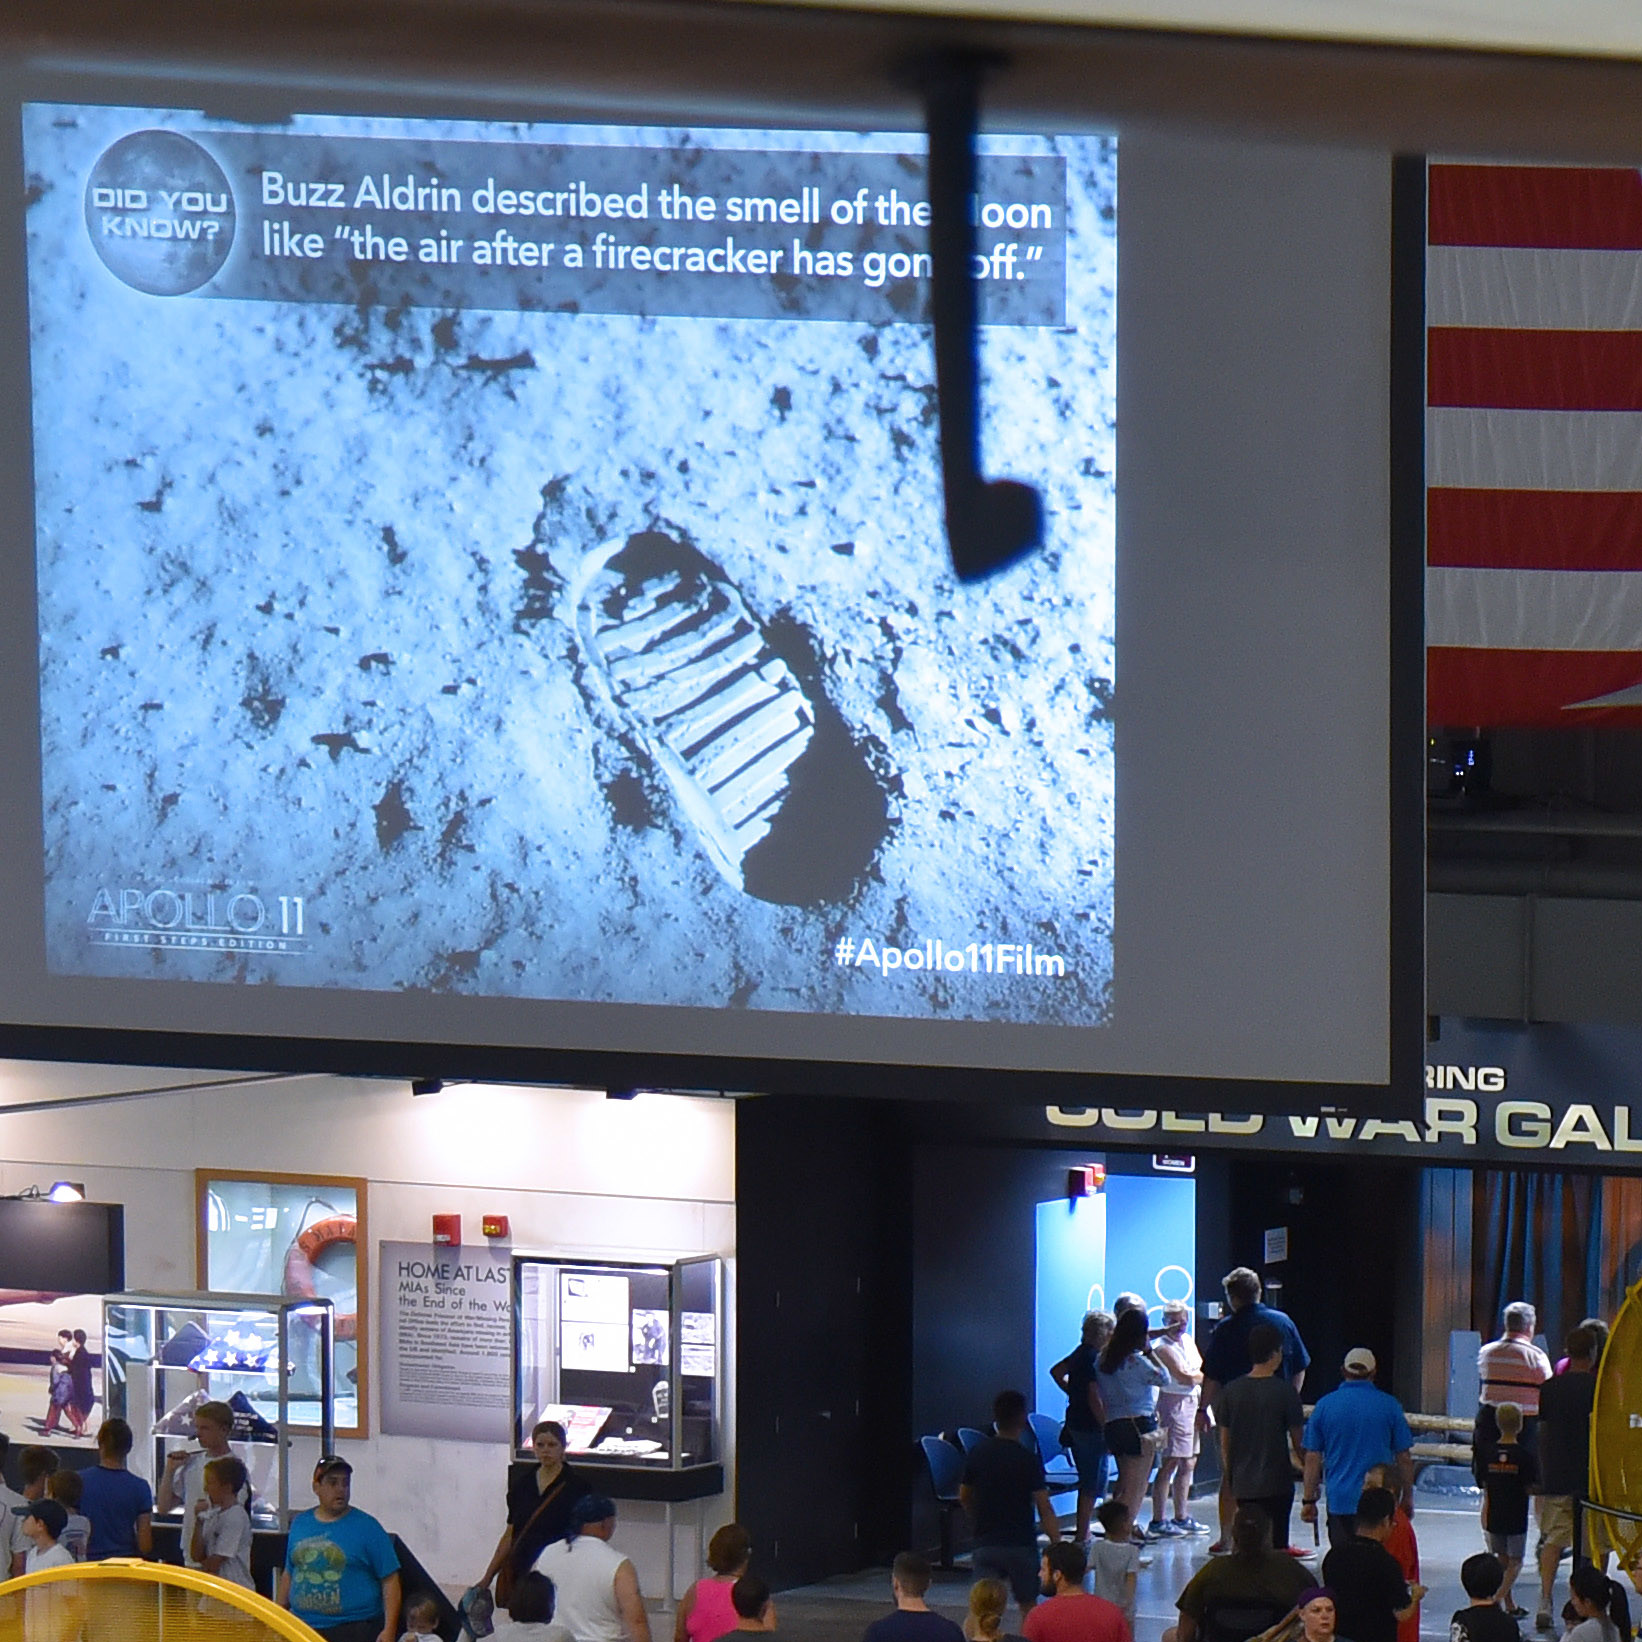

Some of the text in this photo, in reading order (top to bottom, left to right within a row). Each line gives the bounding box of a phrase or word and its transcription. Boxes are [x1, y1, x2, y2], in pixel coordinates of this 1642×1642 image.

[92, 187, 227, 213] DID YOU
[261, 171, 1051, 229] Buzz Aldrin described the smell of the oon
[102, 216, 220, 240] KNOW?
[263, 220, 324, 257] like
[419, 229, 463, 264] air
[471, 229, 554, 266] after
[563, 242, 584, 268] a
[592, 232, 783, 274] firecracker
[793, 238, 853, 276] has
[863, 250, 932, 288] gon
[87, 888, 304, 935] APOLLO 11
[104, 932, 287, 950] FIRST STEPS EDITION
[835, 936, 1065, 977] #Apollo11Film
[398, 1261, 450, 1280] HOME
[453, 1265, 473, 1282] AT
[399, 1282, 466, 1296] MIAs Since
[399, 1294, 417, 1308] the
[423, 1296, 445, 1310] End
[451, 1298, 464, 1311] of
[469, 1299, 487, 1312] the
